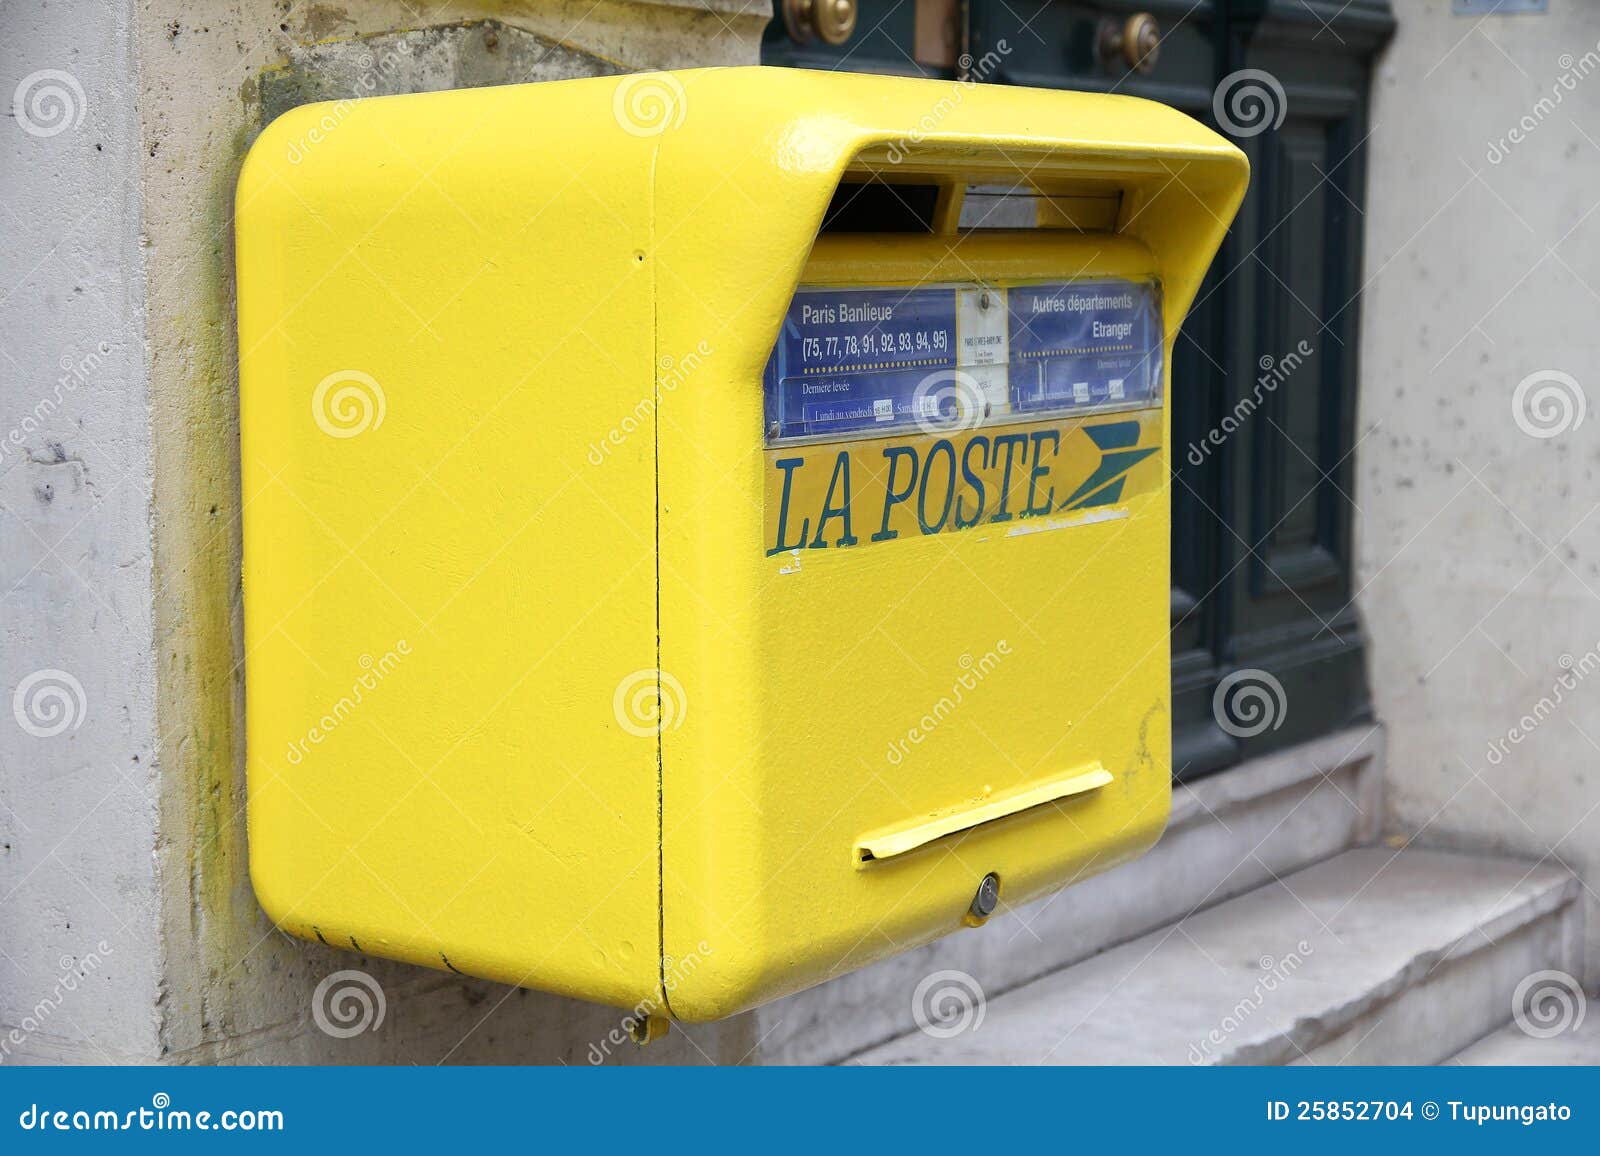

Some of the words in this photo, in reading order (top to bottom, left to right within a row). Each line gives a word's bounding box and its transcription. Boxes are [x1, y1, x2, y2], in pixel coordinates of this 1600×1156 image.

[802, 304, 836, 325] Paris
[839, 302, 893, 323] Banlieue
[1032, 295, 1066, 313] Autres
[1067, 293, 1133, 315] départements
[1092, 320, 1133, 341] Etranger
[802, 337, 823, 362] (75,
[825, 336, 842, 359] 77,
[845, 335, 861, 357] 78,
[863, 334, 879, 356] 91,
[881, 333, 897, 355] 92,
[899, 332, 914, 354] 93,
[916, 331, 931, 353] 94,
[933, 329, 948, 353] 95)
[766, 451, 858, 558] LA
[871, 429, 1060, 541] POSTE
